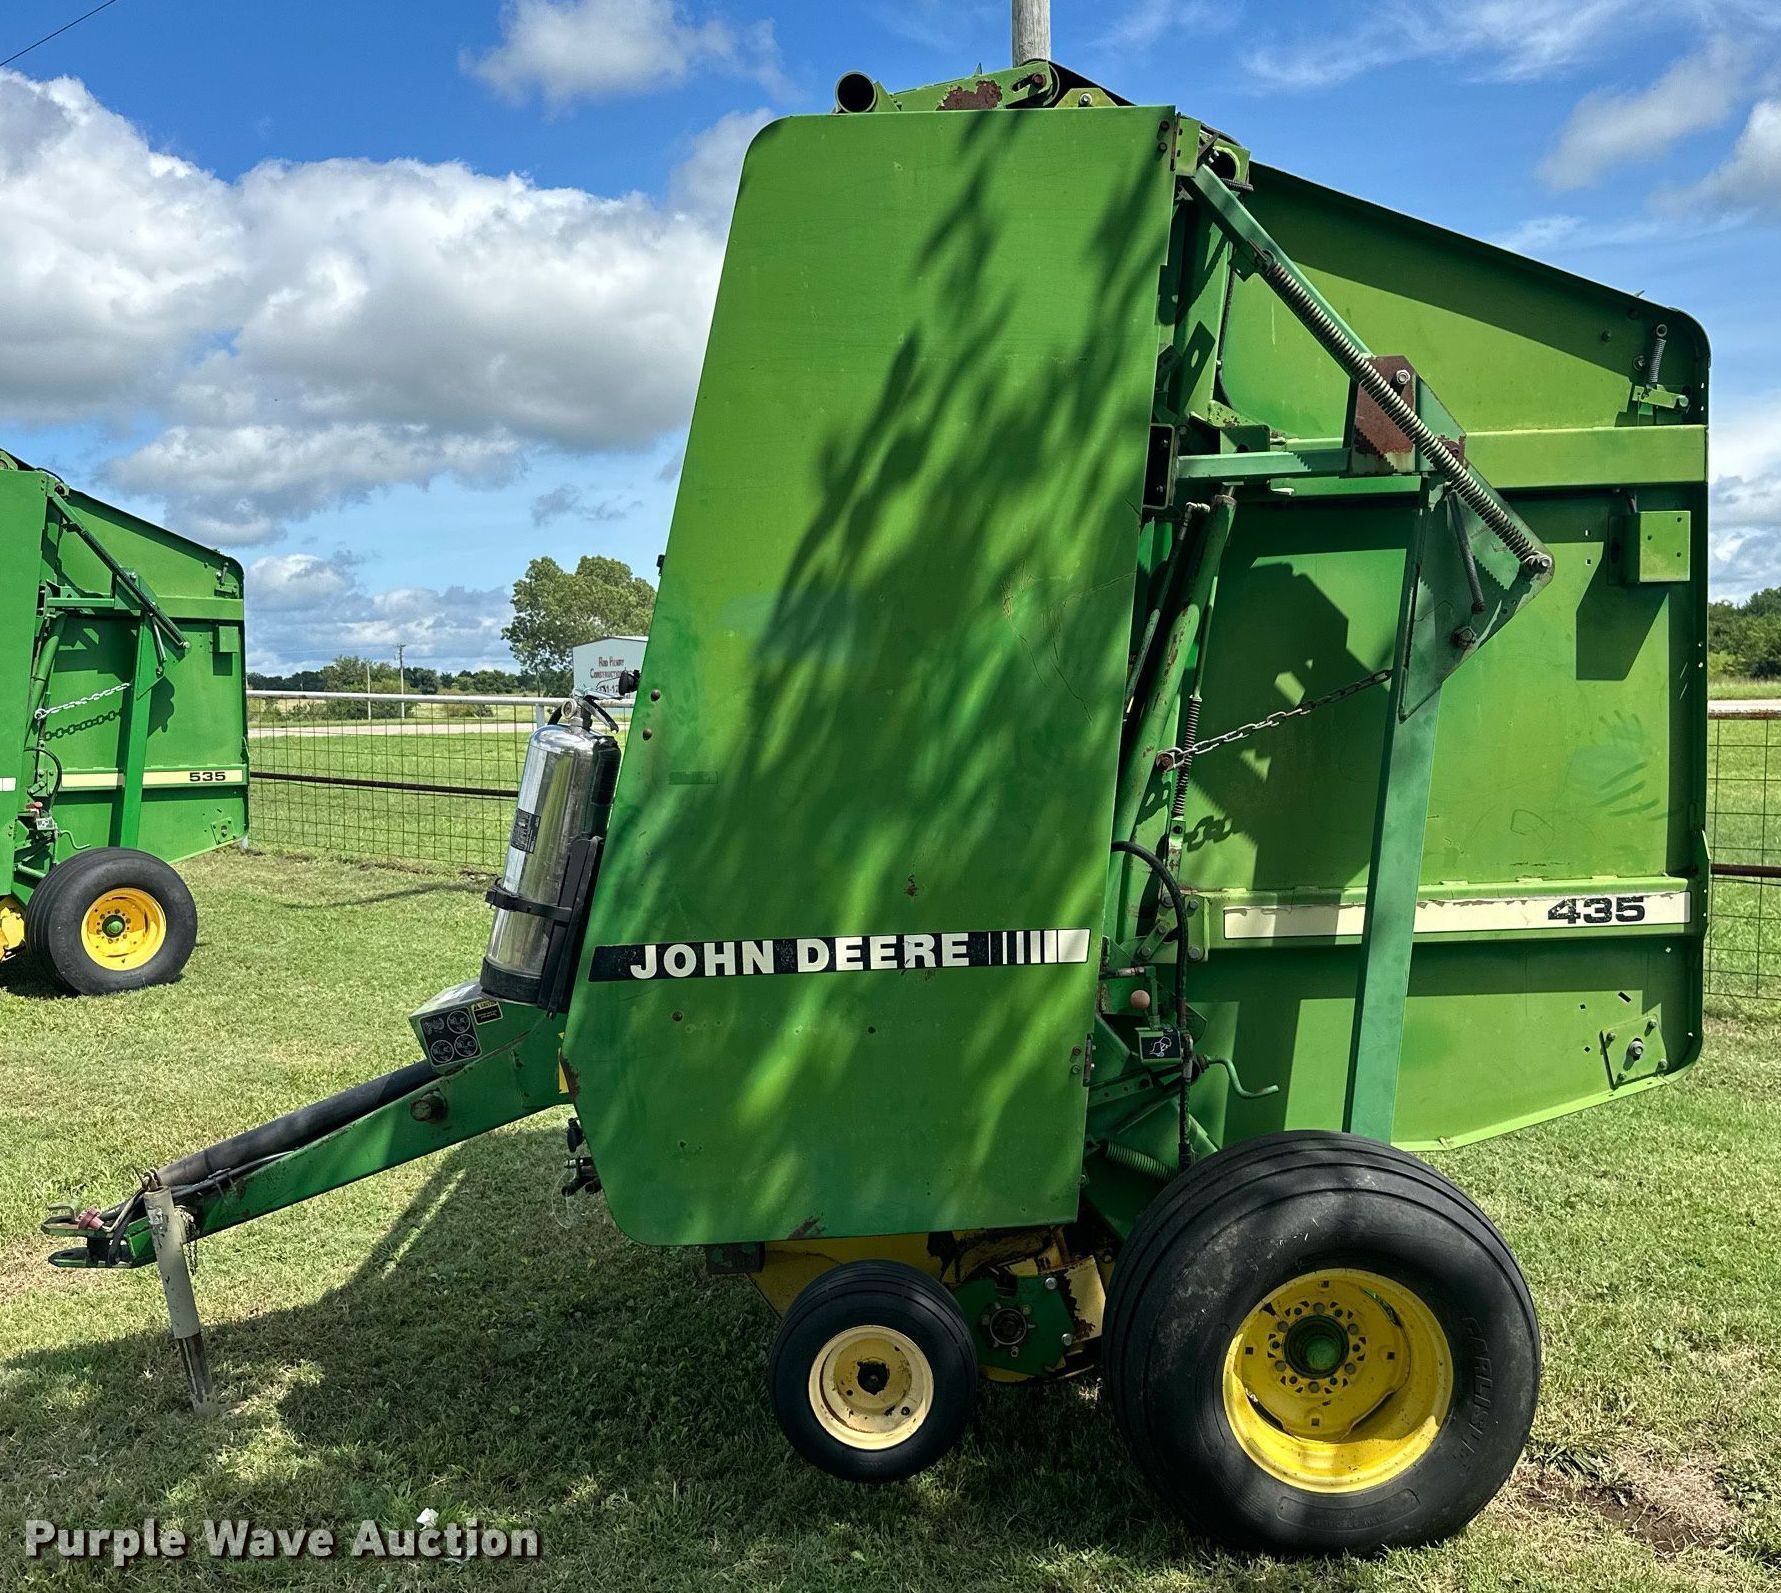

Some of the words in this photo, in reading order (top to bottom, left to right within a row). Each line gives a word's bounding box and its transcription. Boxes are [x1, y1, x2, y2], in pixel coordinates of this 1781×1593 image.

[189, 771, 226, 782] 535
[1547, 896, 1646, 925] 435
[629, 939, 775, 980] JOHN
[796, 932, 970, 973] DEERE
